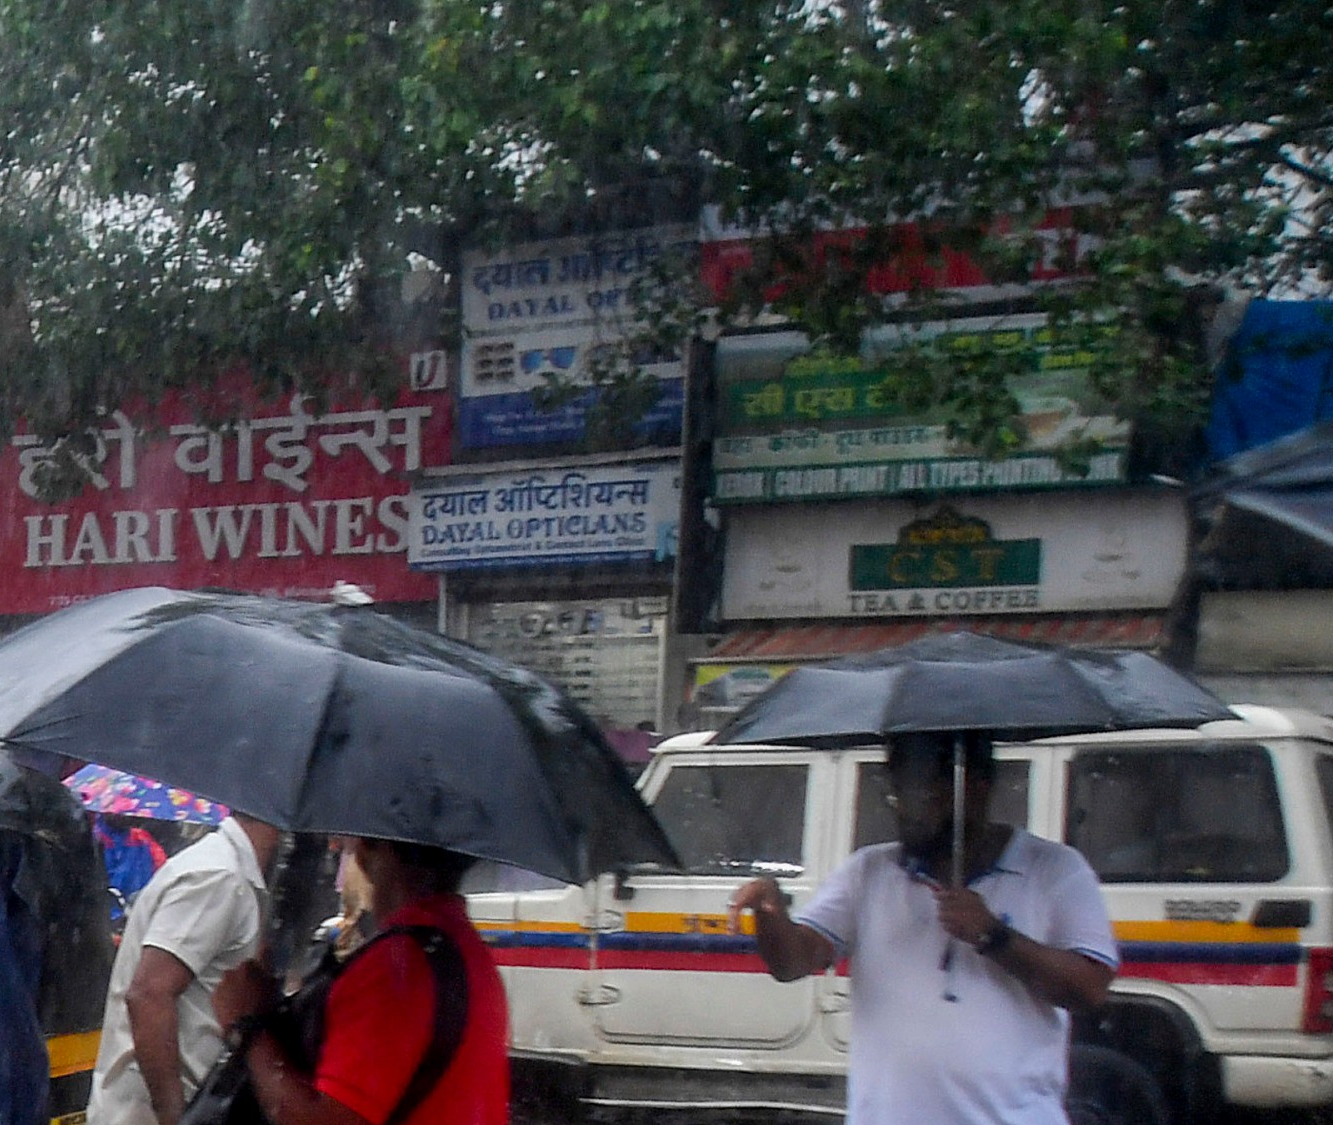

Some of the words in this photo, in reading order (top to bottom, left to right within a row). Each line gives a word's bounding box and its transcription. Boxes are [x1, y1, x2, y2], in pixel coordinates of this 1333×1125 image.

[171, 394, 431, 492] वाईन्स
[422, 489, 490, 519] दयाल
[494, 473, 649, 513] ऑप्टिशियन्स
[24, 508, 178, 567] HARI
[190, 494, 409, 561] WINES
[422, 520, 501, 546] DAYAL
[506, 512, 646, 541] OPTICIANS
[887, 550, 1004, 584] CST
[848, 594, 900, 613] TEA
[904, 592, 924, 611] &
[933, 589, 1037, 611] COFFEE
